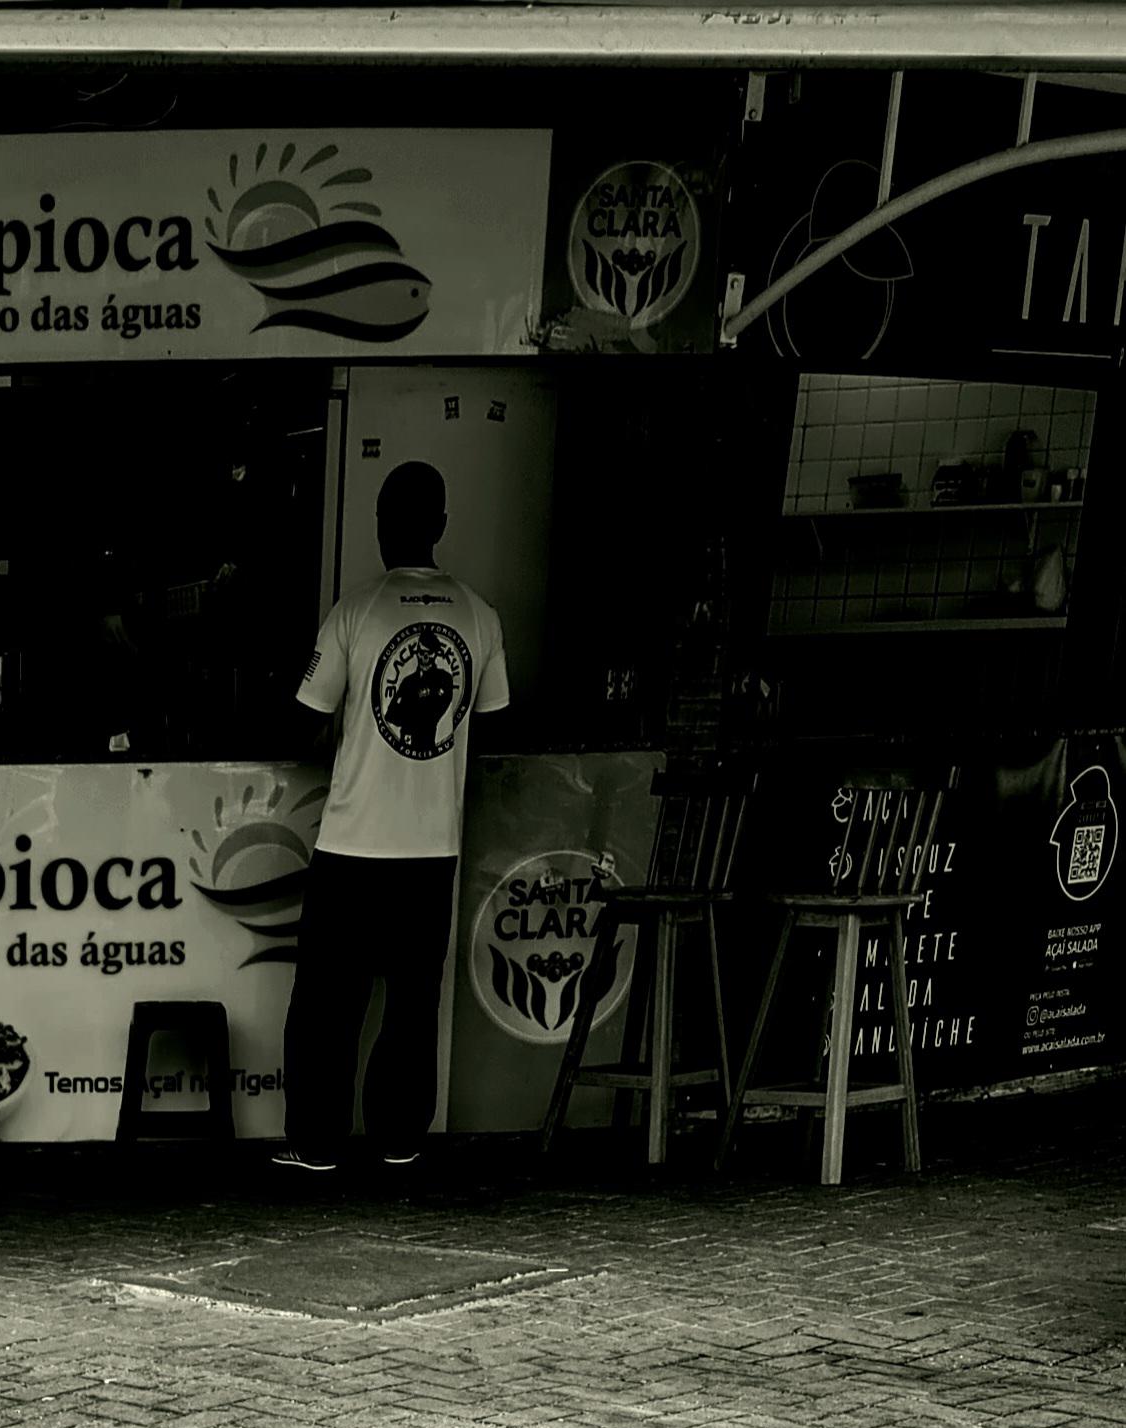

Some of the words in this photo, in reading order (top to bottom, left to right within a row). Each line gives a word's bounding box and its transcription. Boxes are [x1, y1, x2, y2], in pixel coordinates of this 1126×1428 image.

[599, 183, 675, 209] SANTA
[587, 208, 683, 238] CLARA
[1021, 213, 1126, 329] TA
[31, 296, 89, 332] das
[101, 295, 201, 339] águas
[385, 641, 422, 699] BLACK
[6, 933, 68, 967] das
[80, 933, 186, 975] águas
[1045, 938, 1067, 961] AÇAÍ
[1066, 937, 1099, 955] SALADA
[44, 1070, 123, 1094] Temos
